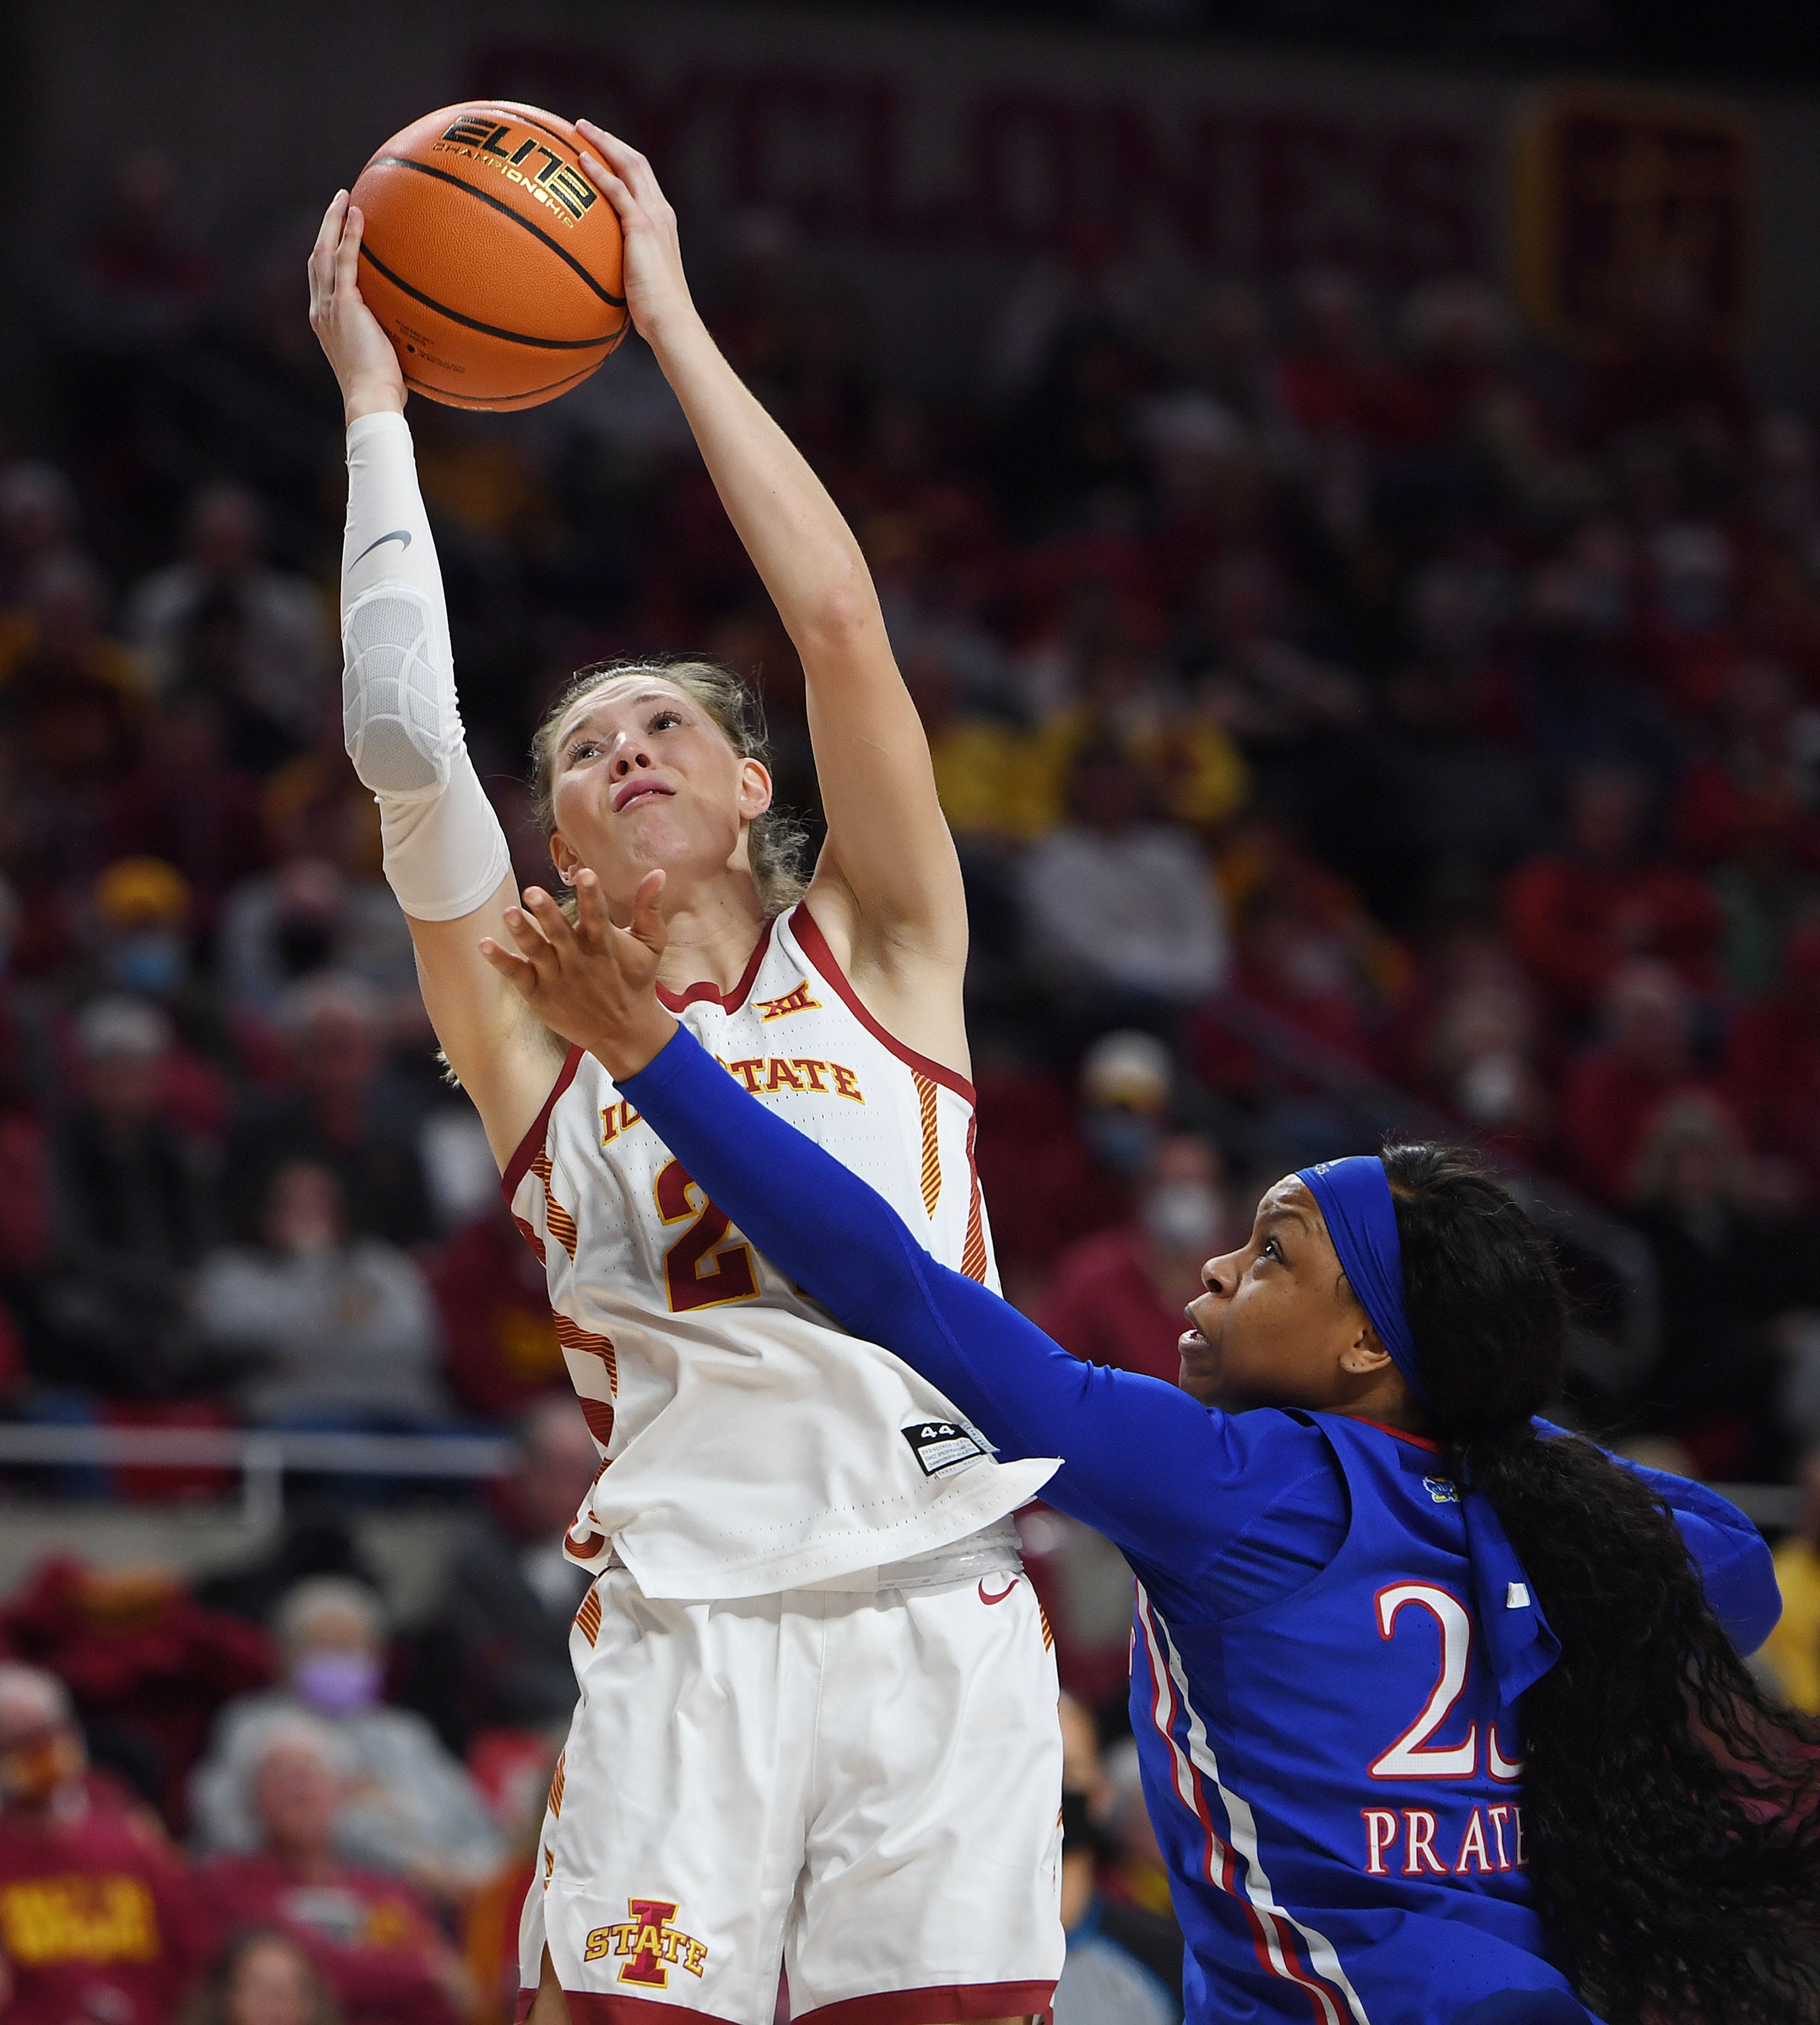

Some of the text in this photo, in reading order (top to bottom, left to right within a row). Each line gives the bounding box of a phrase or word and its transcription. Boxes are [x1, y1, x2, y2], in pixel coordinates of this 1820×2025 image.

[432, 142, 574, 228] CHAMPIONSHIP
[441, 116, 597, 221] ELITE
[751, 977, 822, 1023] XII
[599, 1053, 865, 1147] IO TATE
[652, 1156, 814, 1313] 2
[921, 1425, 955, 1438] 44
[1367, 1580, 1527, 1783] 2
[1360, 1801, 1531, 1876] PRATE
[584, 1924, 708, 1979] STATE
